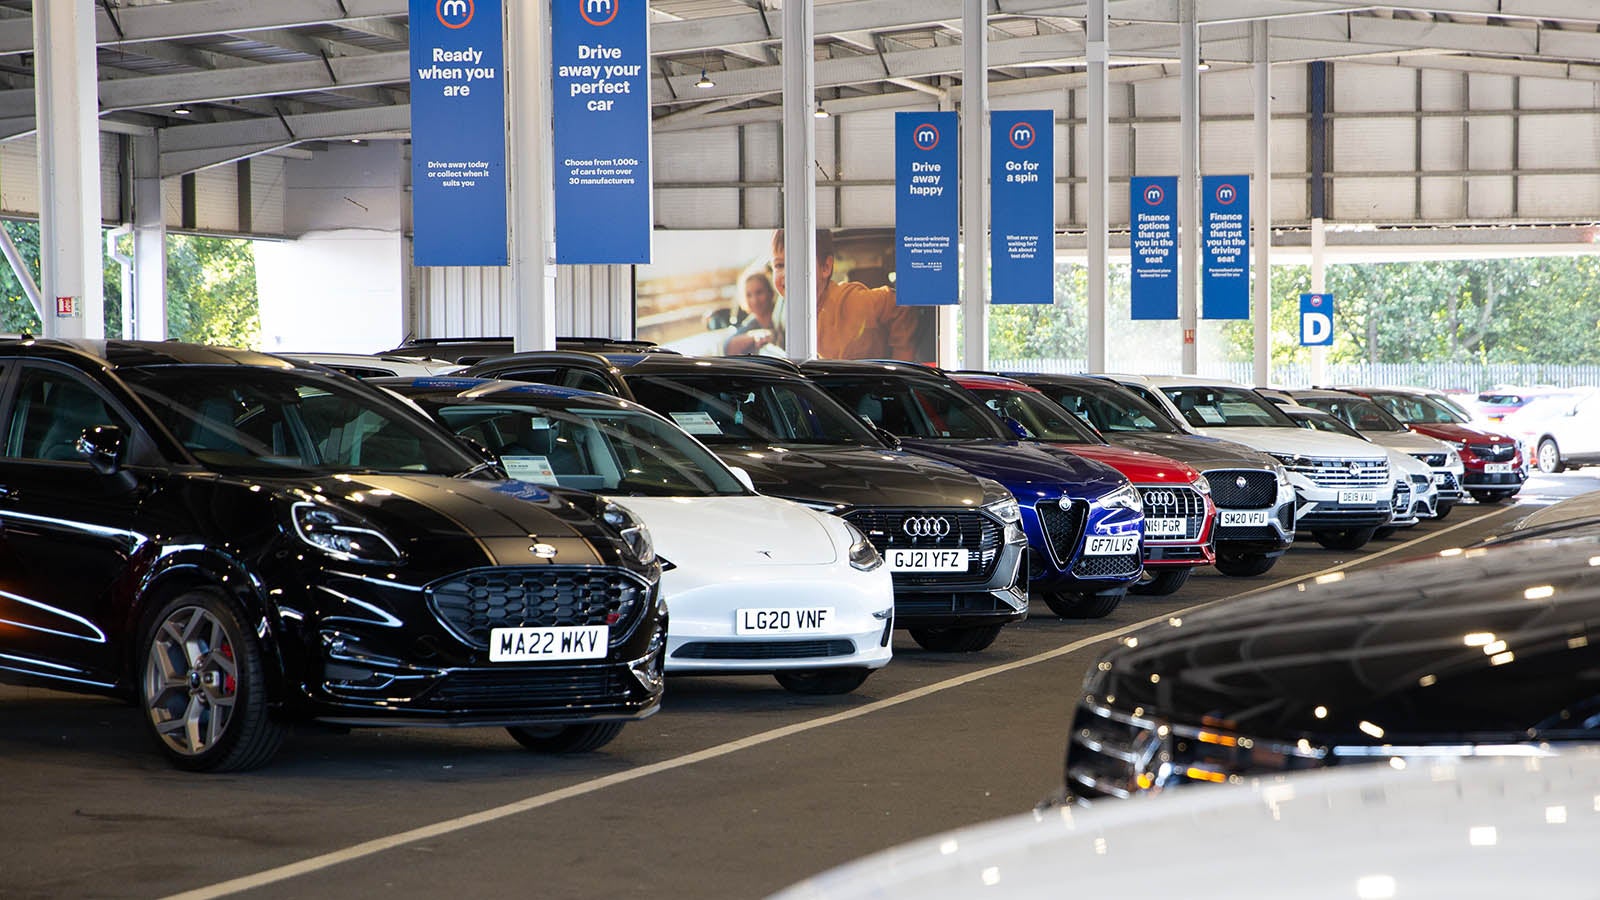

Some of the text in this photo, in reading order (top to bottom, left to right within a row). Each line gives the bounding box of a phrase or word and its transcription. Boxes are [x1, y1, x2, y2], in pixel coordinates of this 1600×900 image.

[433, 47, 482, 64] Ready
[579, 45, 621, 59] Drive
[418, 65, 495, 82] when you
[559, 65, 641, 79] away your
[443, 85, 470, 97] are
[570, 80, 631, 97] perfect
[587, 101, 613, 111] car
[913, 162, 941, 171] Drive
[1006, 161, 1039, 170] Go for
[913, 176, 940, 184] away
[1015, 172, 1038, 183] spin
[910, 185, 943, 196] happy
[1139, 222, 1169, 231] options
[1211, 221, 1241, 230] options
[1156, 231, 1169, 239] put
[1139, 247, 1168, 256] driving
[1211, 246, 1240, 255] driving
[1303, 313, 1331, 343] D
[1361, 493, 1372, 501] VAU
[1225, 513, 1264, 523] SM20 VFU
[1144, 519, 1180, 532] N19 PGR
[1092, 539, 1133, 551] GF71 LVS
[896, 552, 958, 567] GJ21 YFZ
[745, 610, 827, 629] LG20 VNF
[501, 631, 597, 654] MA22 WKV
